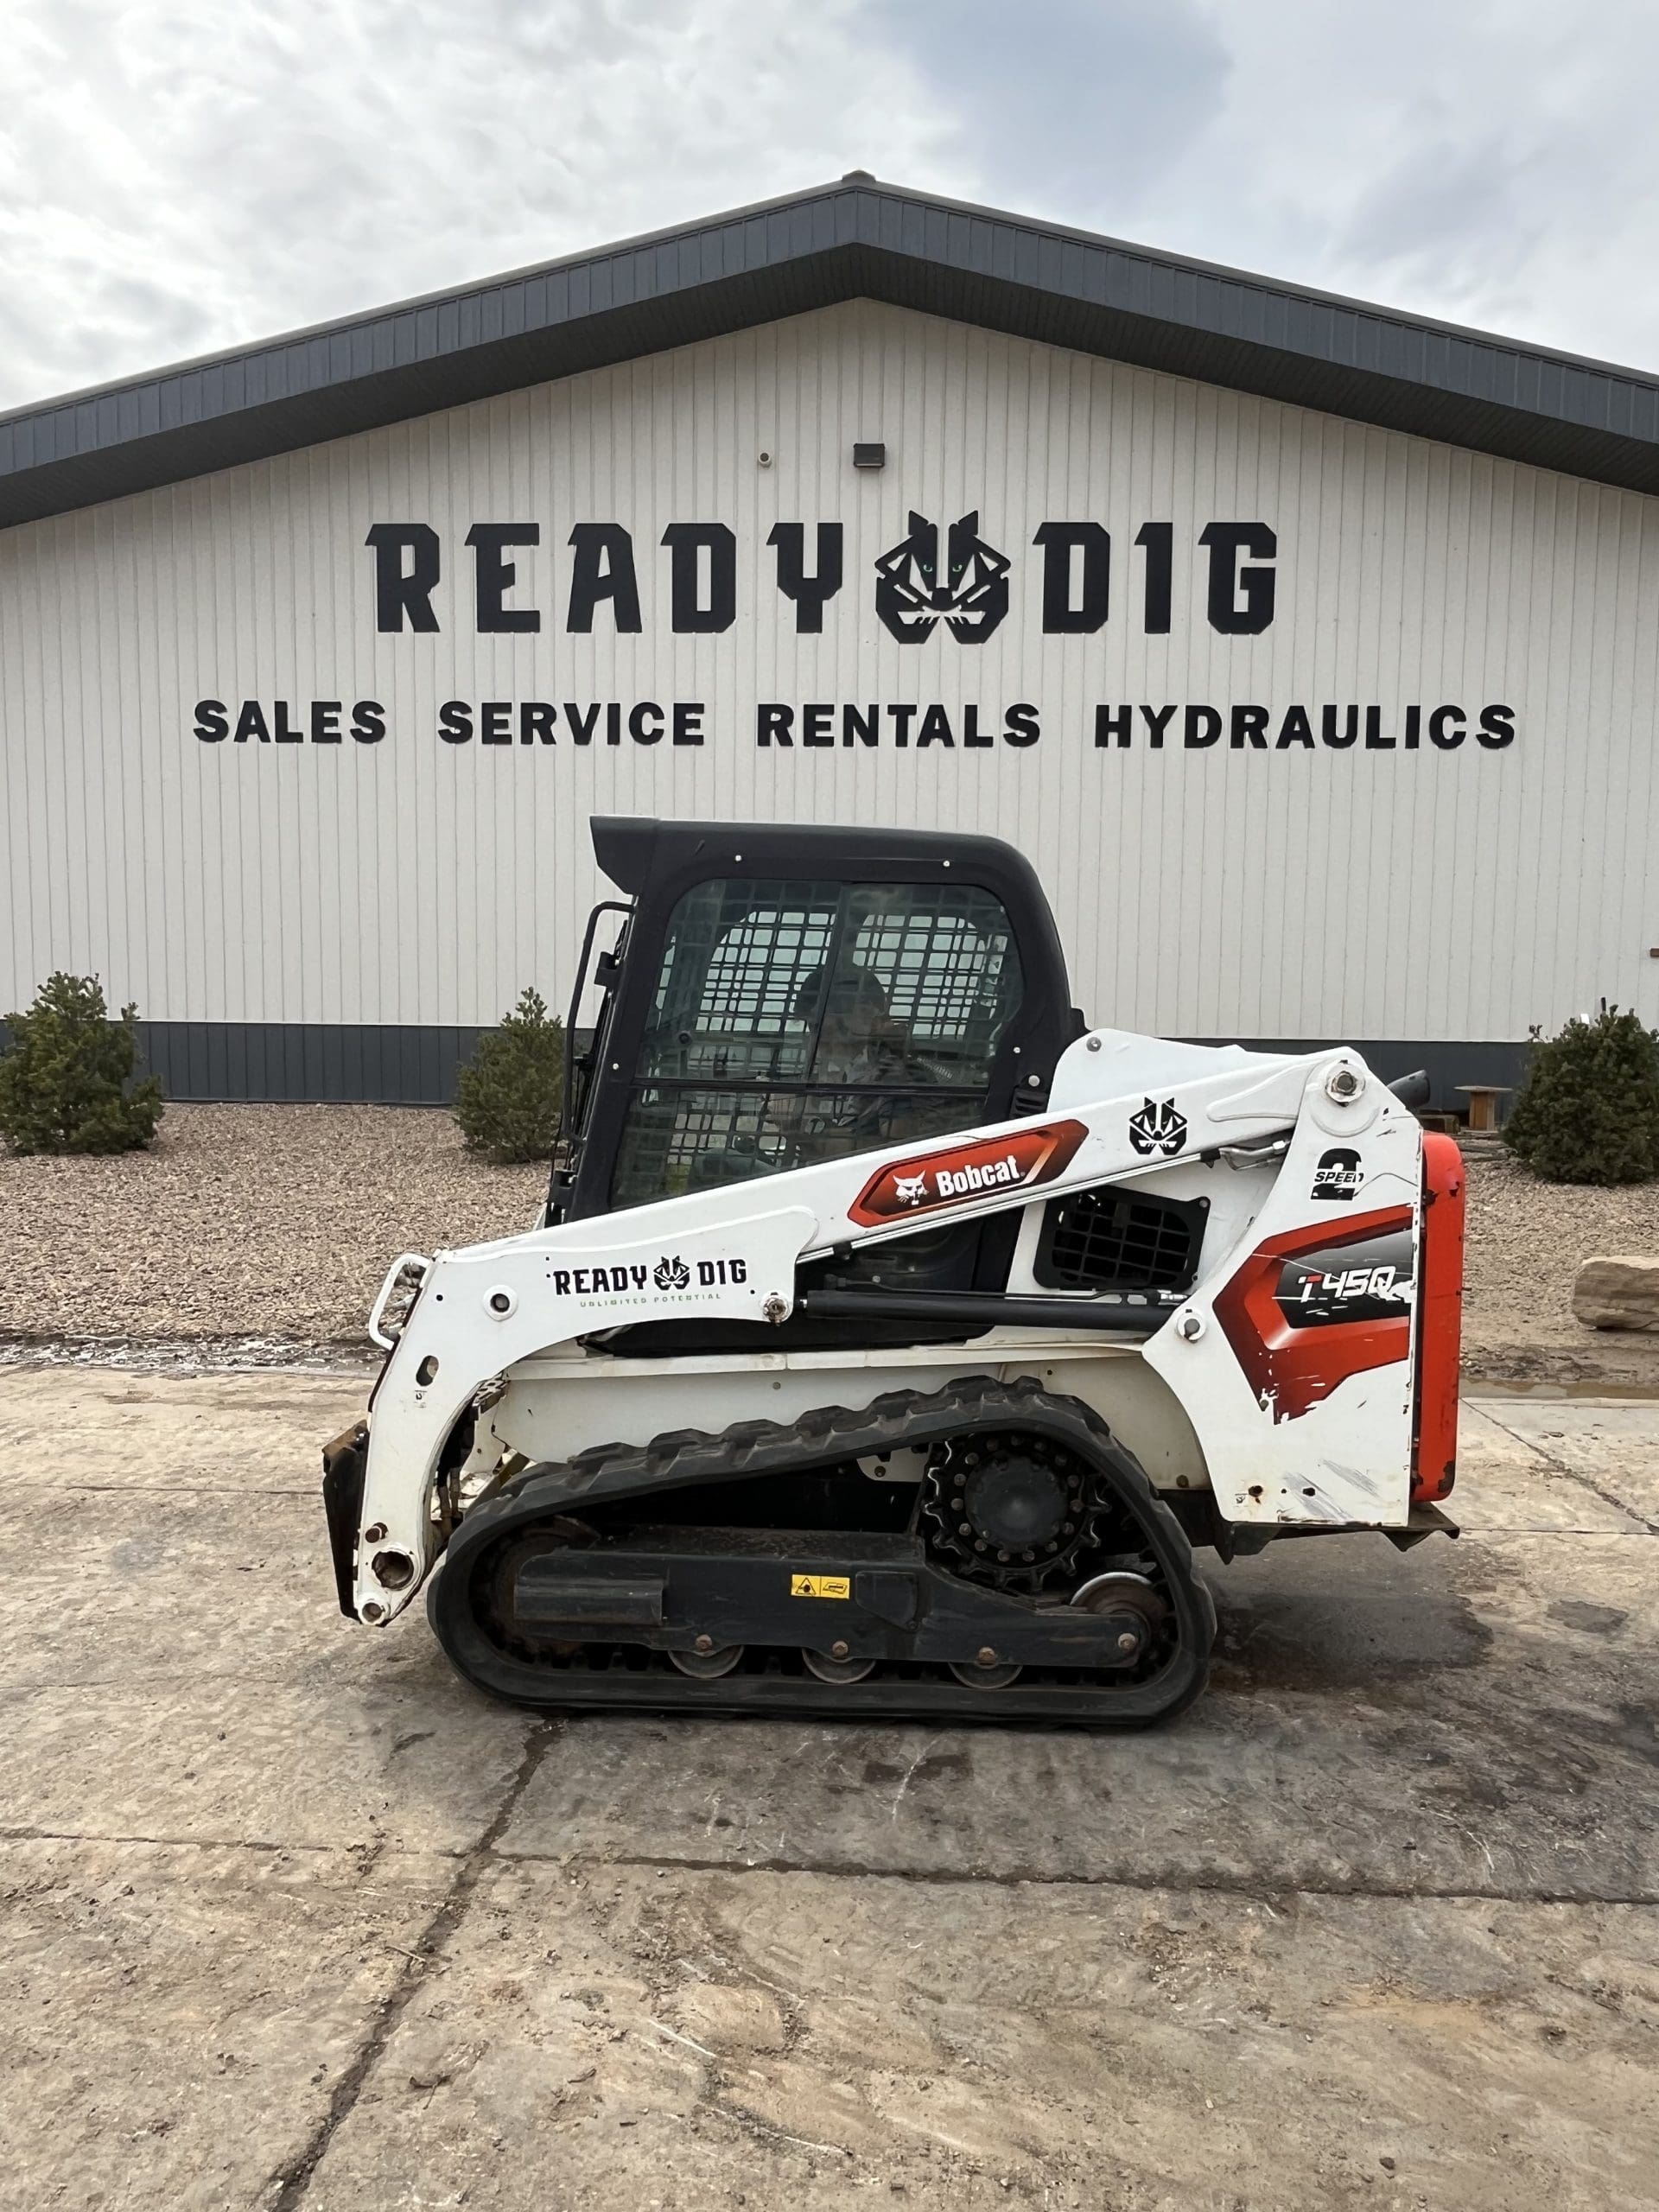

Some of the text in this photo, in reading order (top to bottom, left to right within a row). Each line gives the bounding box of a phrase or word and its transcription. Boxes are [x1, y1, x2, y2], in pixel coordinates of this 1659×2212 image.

[365, 522, 1276, 634] READY DIG
[193, 700, 1516, 750] SALES SERVICE RENTALS HYDRAULICS
[935, 1154, 1020, 1197] Bobcat
[1314, 1172, 1364, 1183] SPEED
[553, 1259, 747, 1295] READY DIG
[1298, 1266, 1396, 1303] T450
[580, 1294, 721, 1307] UNLIMITED POTENTIAL
